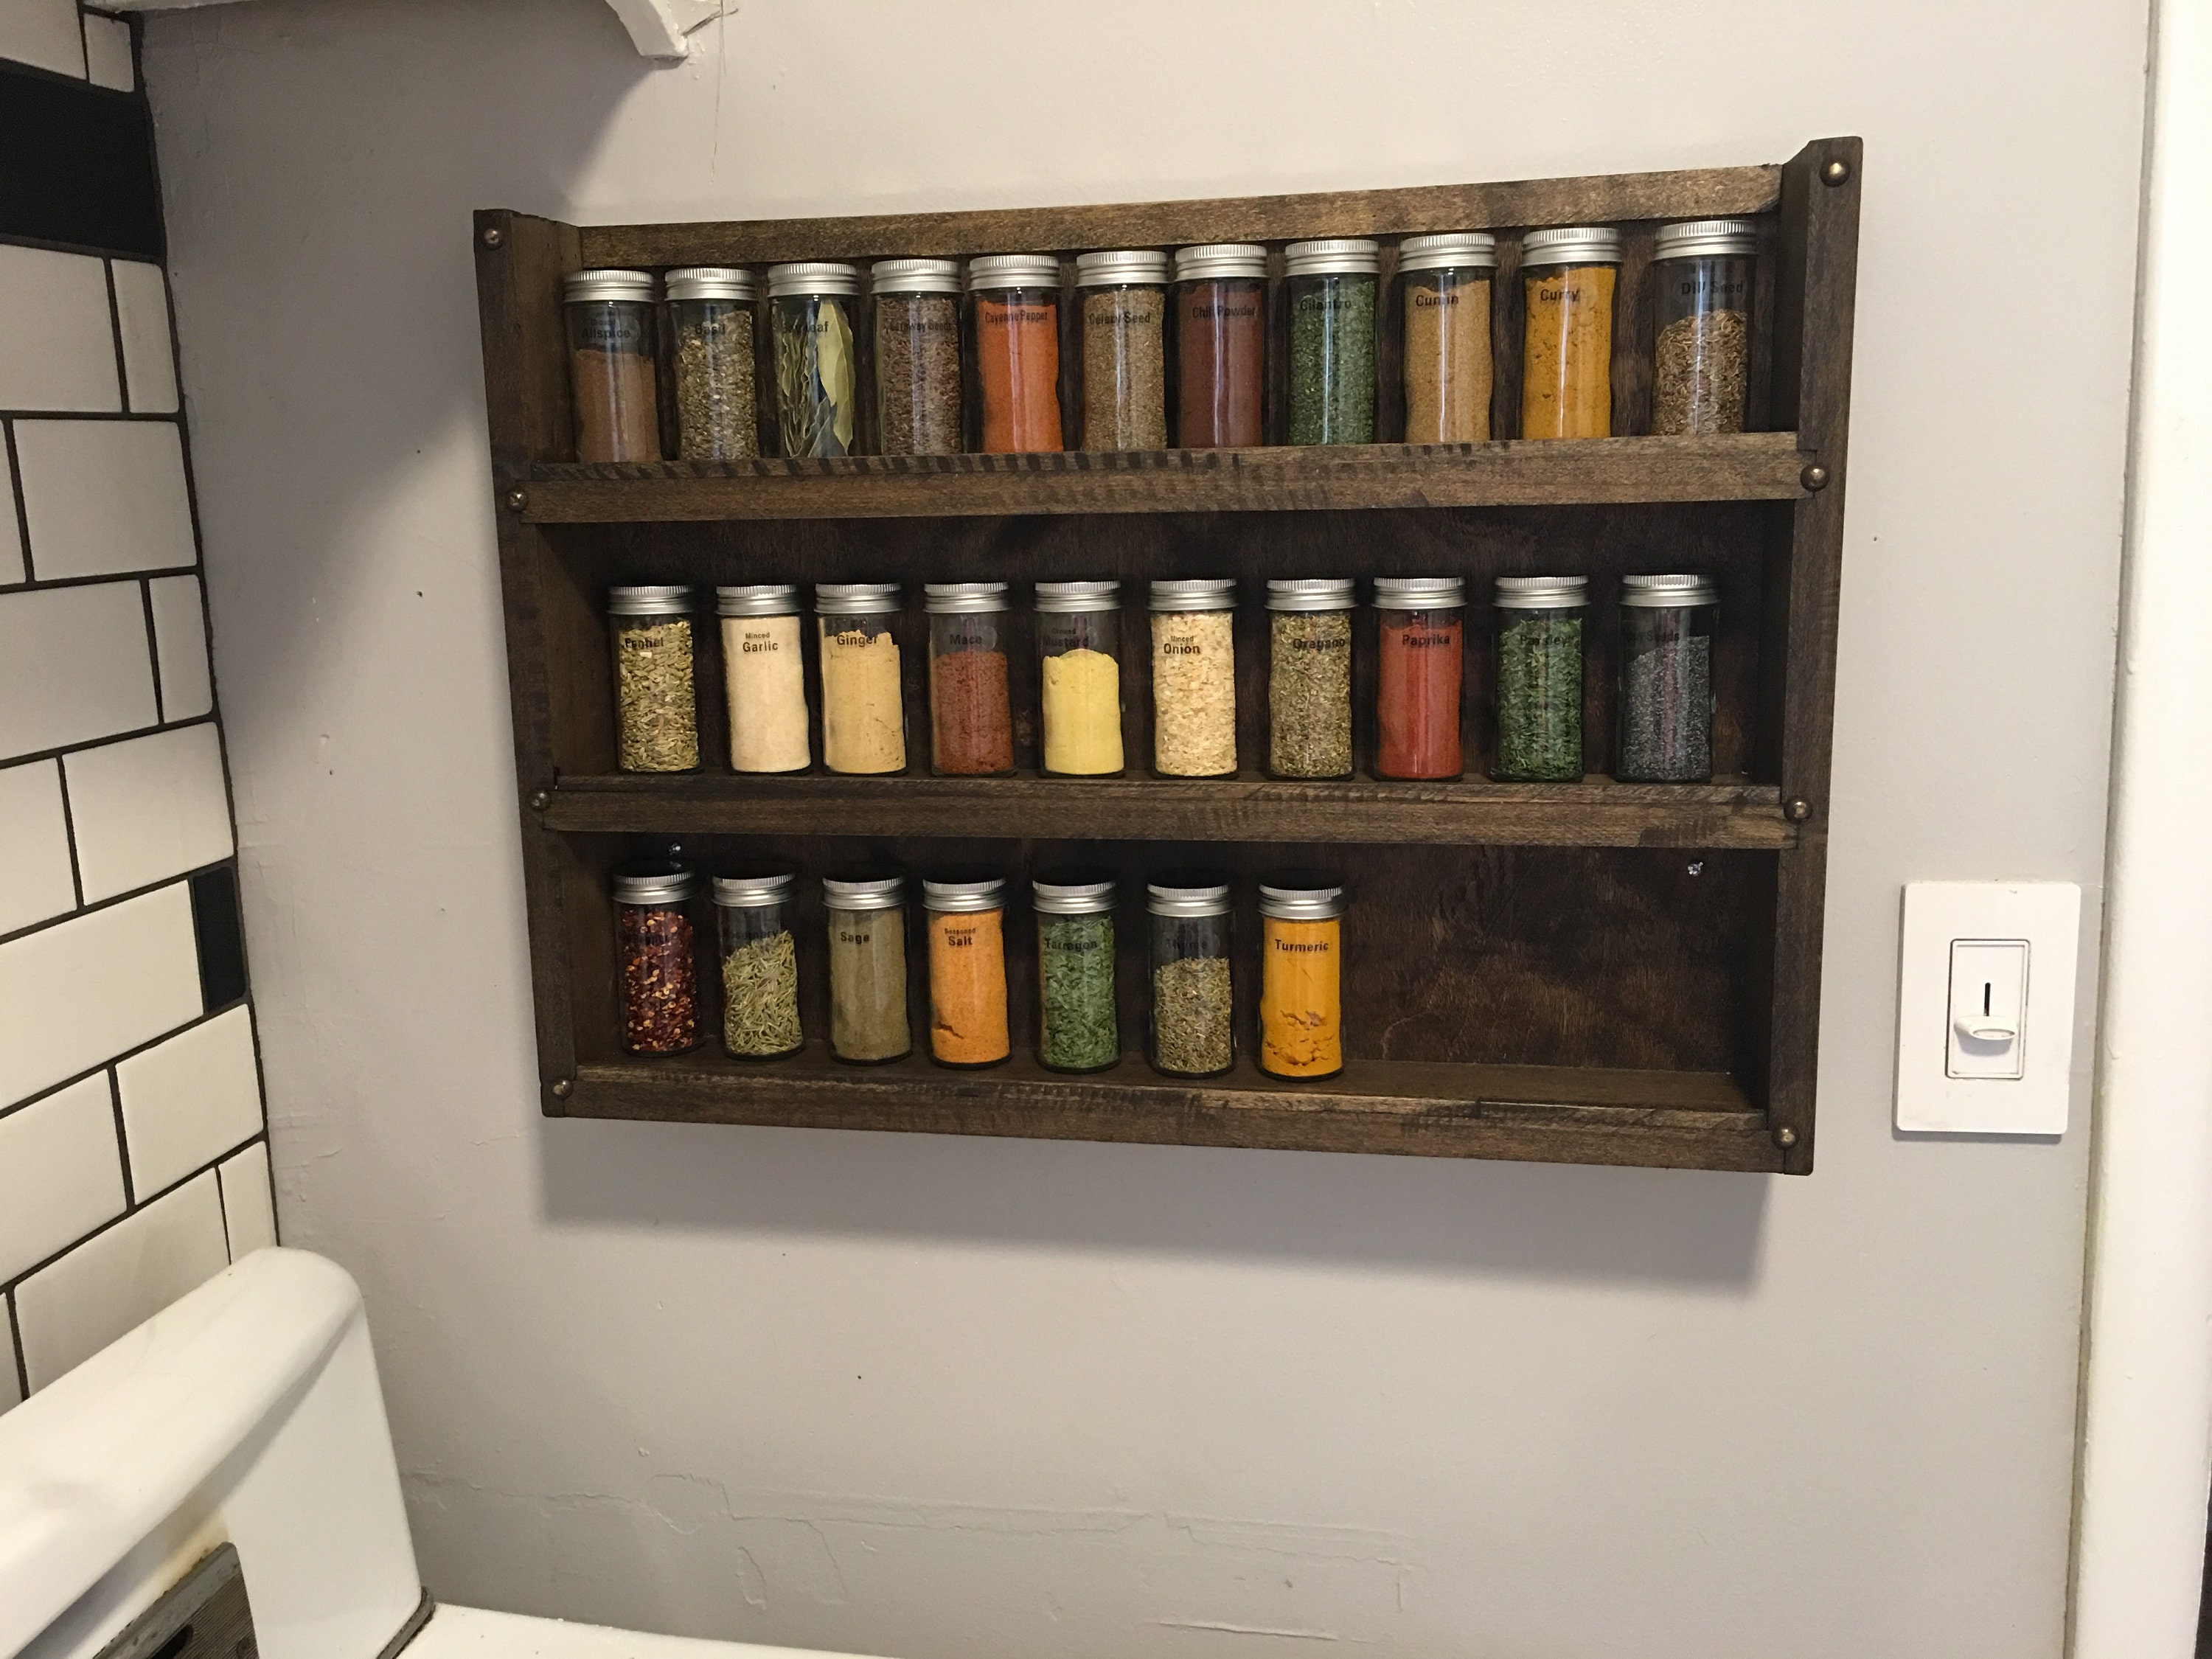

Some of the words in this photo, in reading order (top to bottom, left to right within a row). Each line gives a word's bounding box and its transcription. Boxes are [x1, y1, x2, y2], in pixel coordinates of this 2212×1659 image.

[985, 312, 1018, 325] Cayenne
[1020, 310, 1048, 323] Pepper
[1124, 311, 1150, 323] Seed
[1217, 305, 1256, 318] Powder
[582, 327, 631, 340] Allspice
[695, 324, 726, 335] Basil
[837, 635, 878, 647] Ginger
[950, 633, 983, 644] Mace
[1043, 636, 1090, 647] Mustard
[1402, 634, 1450, 648] Paprika
[742, 641, 779, 653] Garlic
[1164, 642, 1201, 655] Onion
[1293, 639, 1346, 651] Oregano
[841, 931, 871, 945] Sage
[947, 936, 973, 946] Salt
[1044, 937, 1098, 952] Tarragon
[1274, 938, 1329, 953] Turmeric
